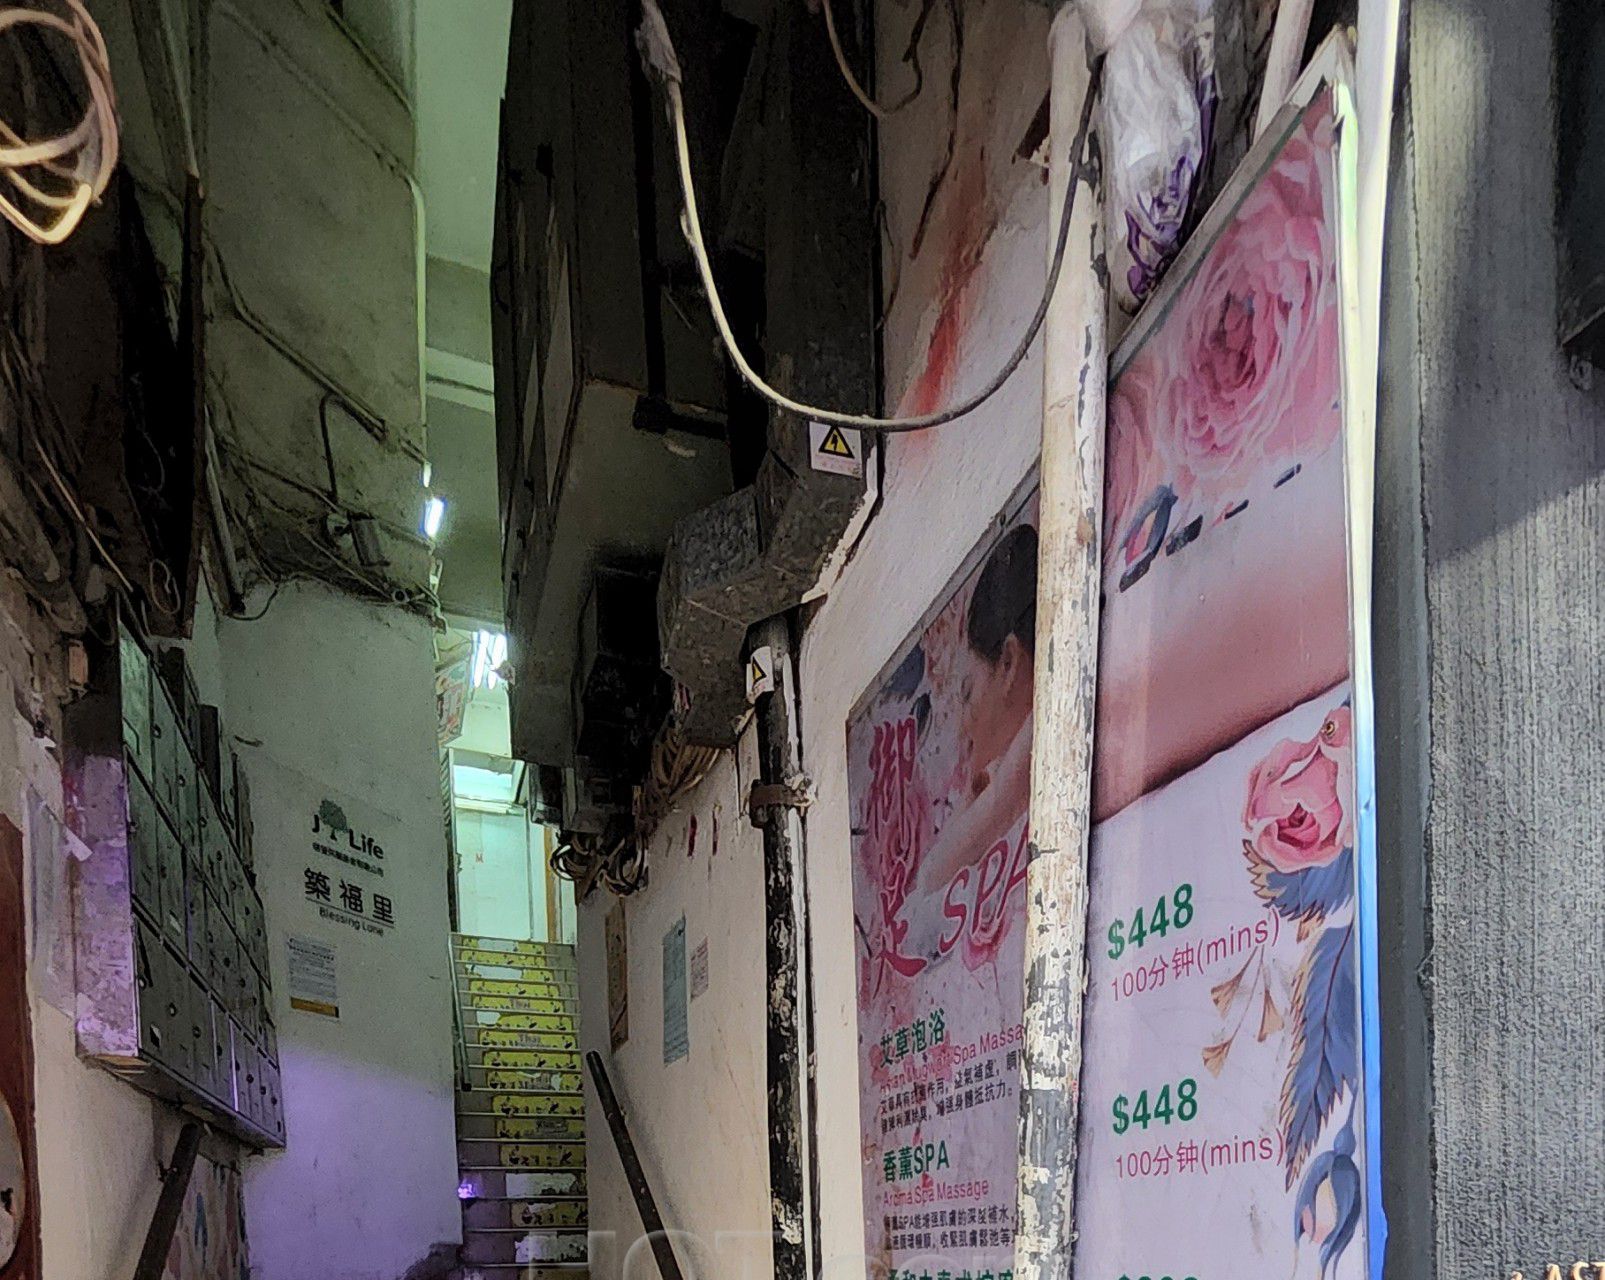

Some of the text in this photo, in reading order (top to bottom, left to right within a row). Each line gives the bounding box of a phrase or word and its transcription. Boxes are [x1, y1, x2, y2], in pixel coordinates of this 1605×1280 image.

[349, 829, 384, 860] Life
[304, 867, 394, 925] 築福里
[1107, 883, 1194, 961] $448
[1111, 908, 1282, 1001] 100分钟(mins)
[880, 1008, 945, 1068] 艾草泡浴
[953, 1043, 977, 1066] Spa
[1112, 1078, 1198, 1135] $448
[883, 1140, 950, 1183] 香薰SPA
[1115, 1128, 1285, 1179] 100分钟(mins)
[914, 1185, 934, 1207] Spa
[937, 1180, 989, 1201] Massage
